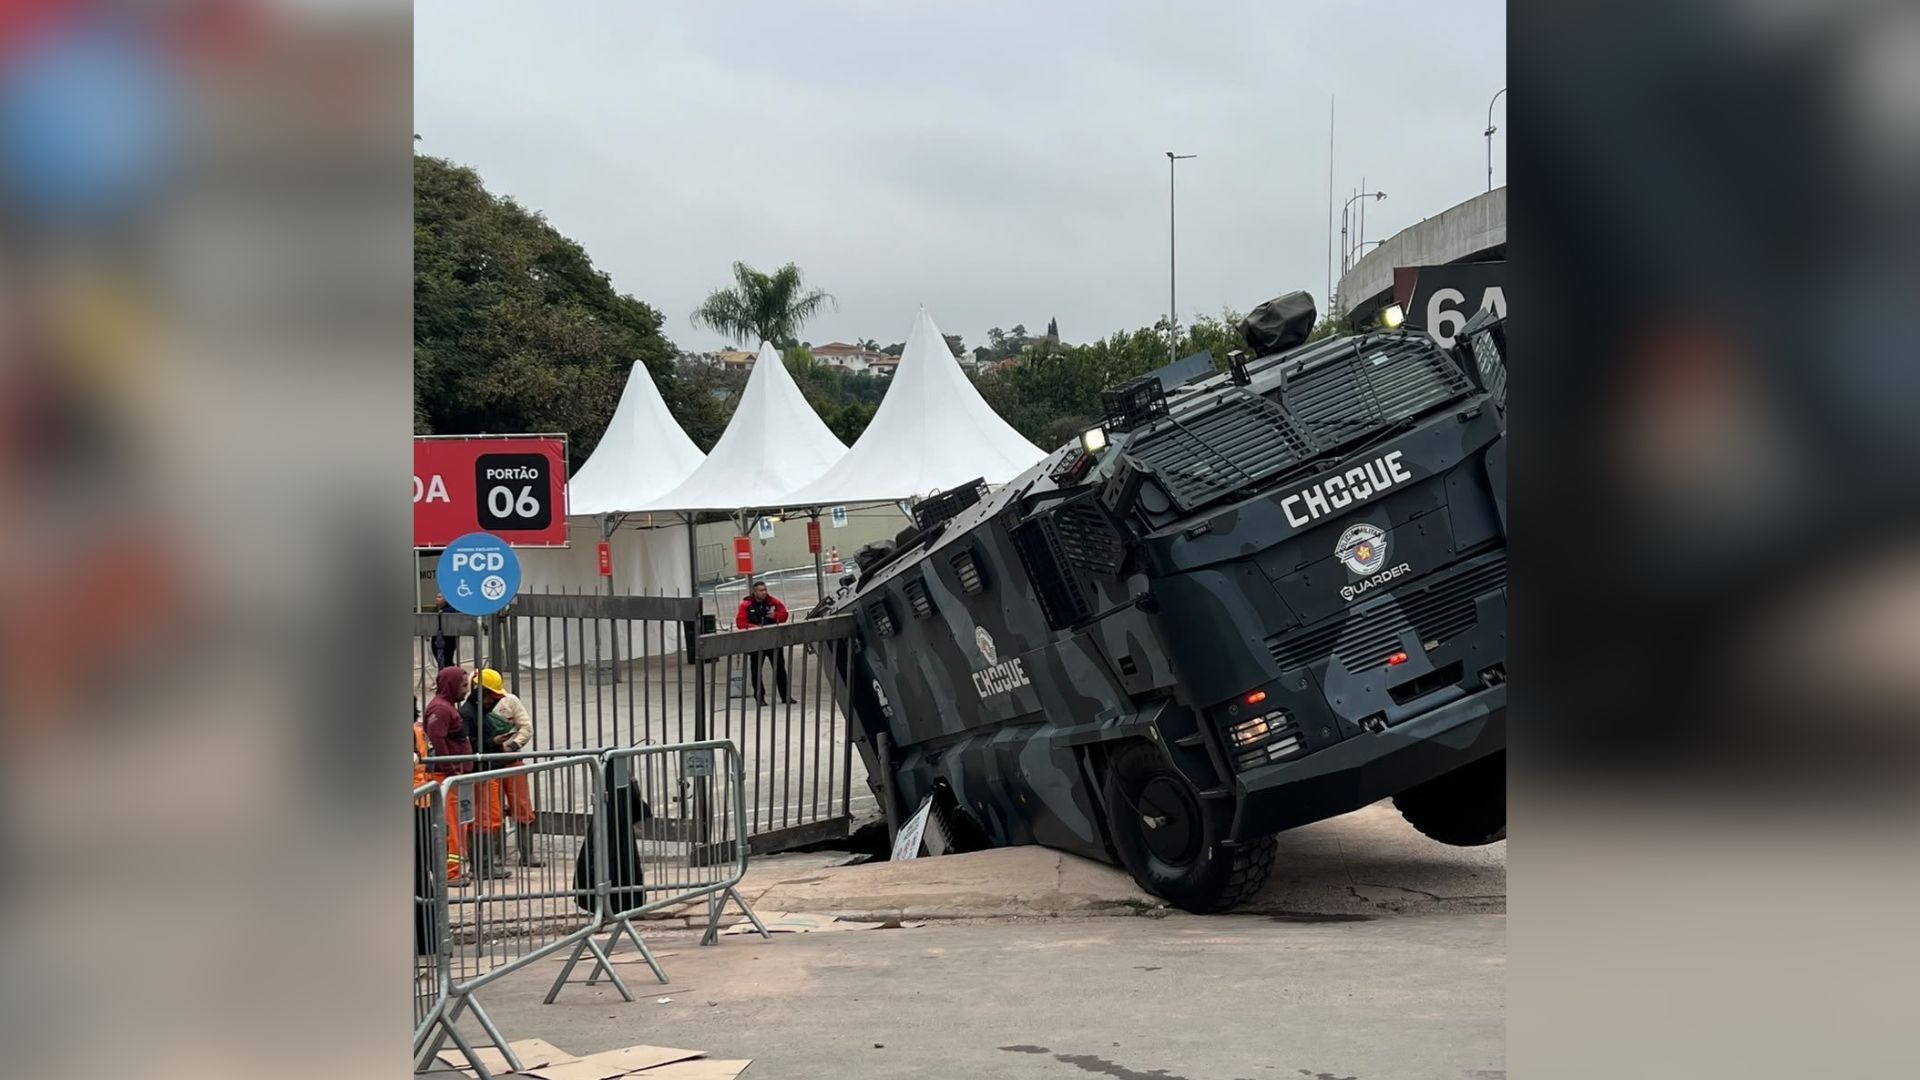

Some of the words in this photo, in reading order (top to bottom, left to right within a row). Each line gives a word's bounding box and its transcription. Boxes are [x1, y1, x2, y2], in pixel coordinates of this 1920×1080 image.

[487, 466, 539, 480] PORTÃO
[1280, 450, 1412, 528] CHOQUE
[488, 485, 540, 518] 06
[453, 552, 505, 571] PCD
[1340, 563, 1412, 601] GUARDER
[972, 657, 1031, 698] CHOQUE
